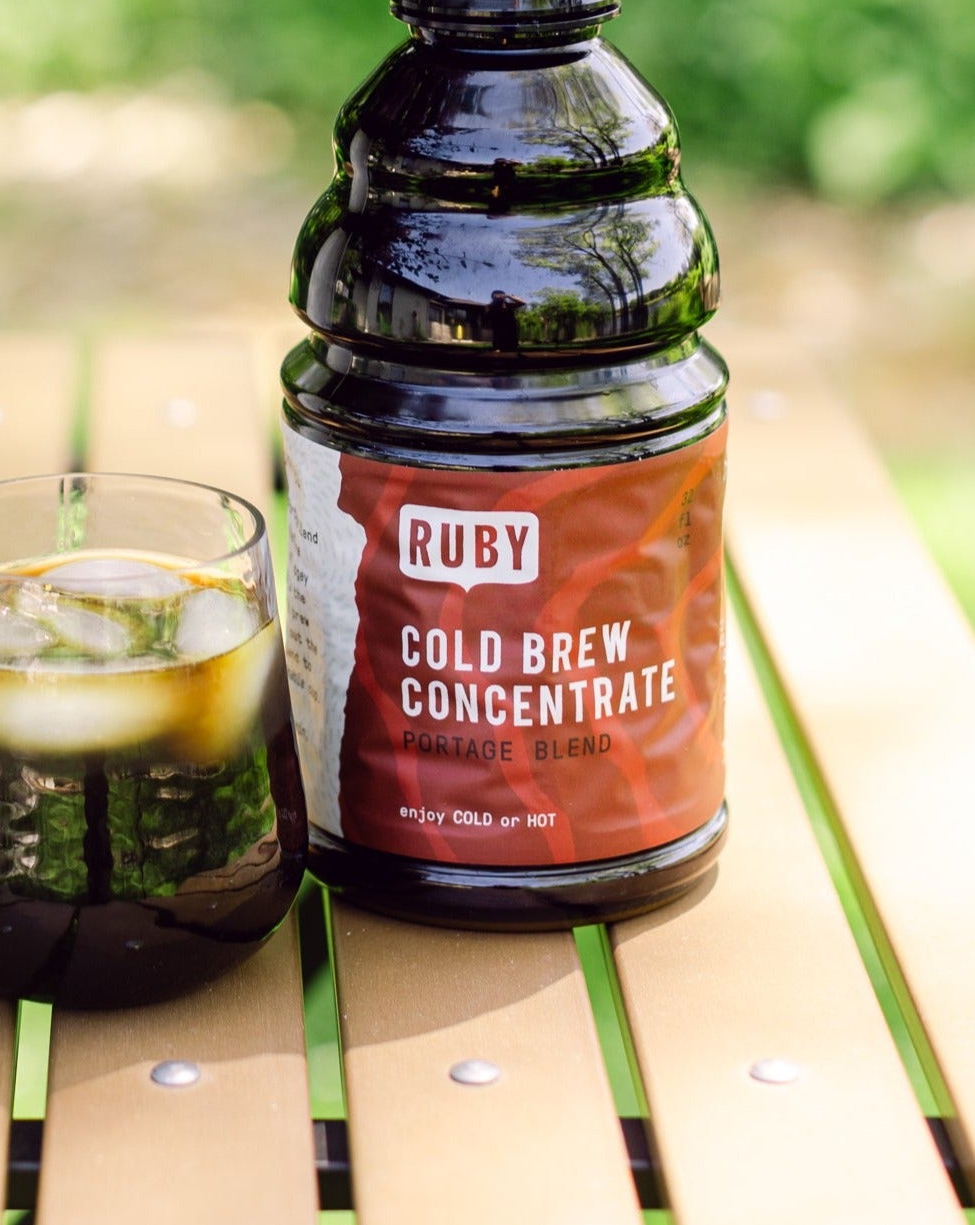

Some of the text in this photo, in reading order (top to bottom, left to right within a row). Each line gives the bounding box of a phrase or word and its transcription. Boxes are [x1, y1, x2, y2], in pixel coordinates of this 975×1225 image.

[681, 487, 695, 506] 32
[410, 518, 529, 571] RUBY
[401, 620, 631, 674] COLD BREW
[401, 659, 675, 727] CONCENTRATE
[403, 730, 612, 761] PORTAGE BLEND
[399, 806, 557, 827] enjoy COLD or HOT
